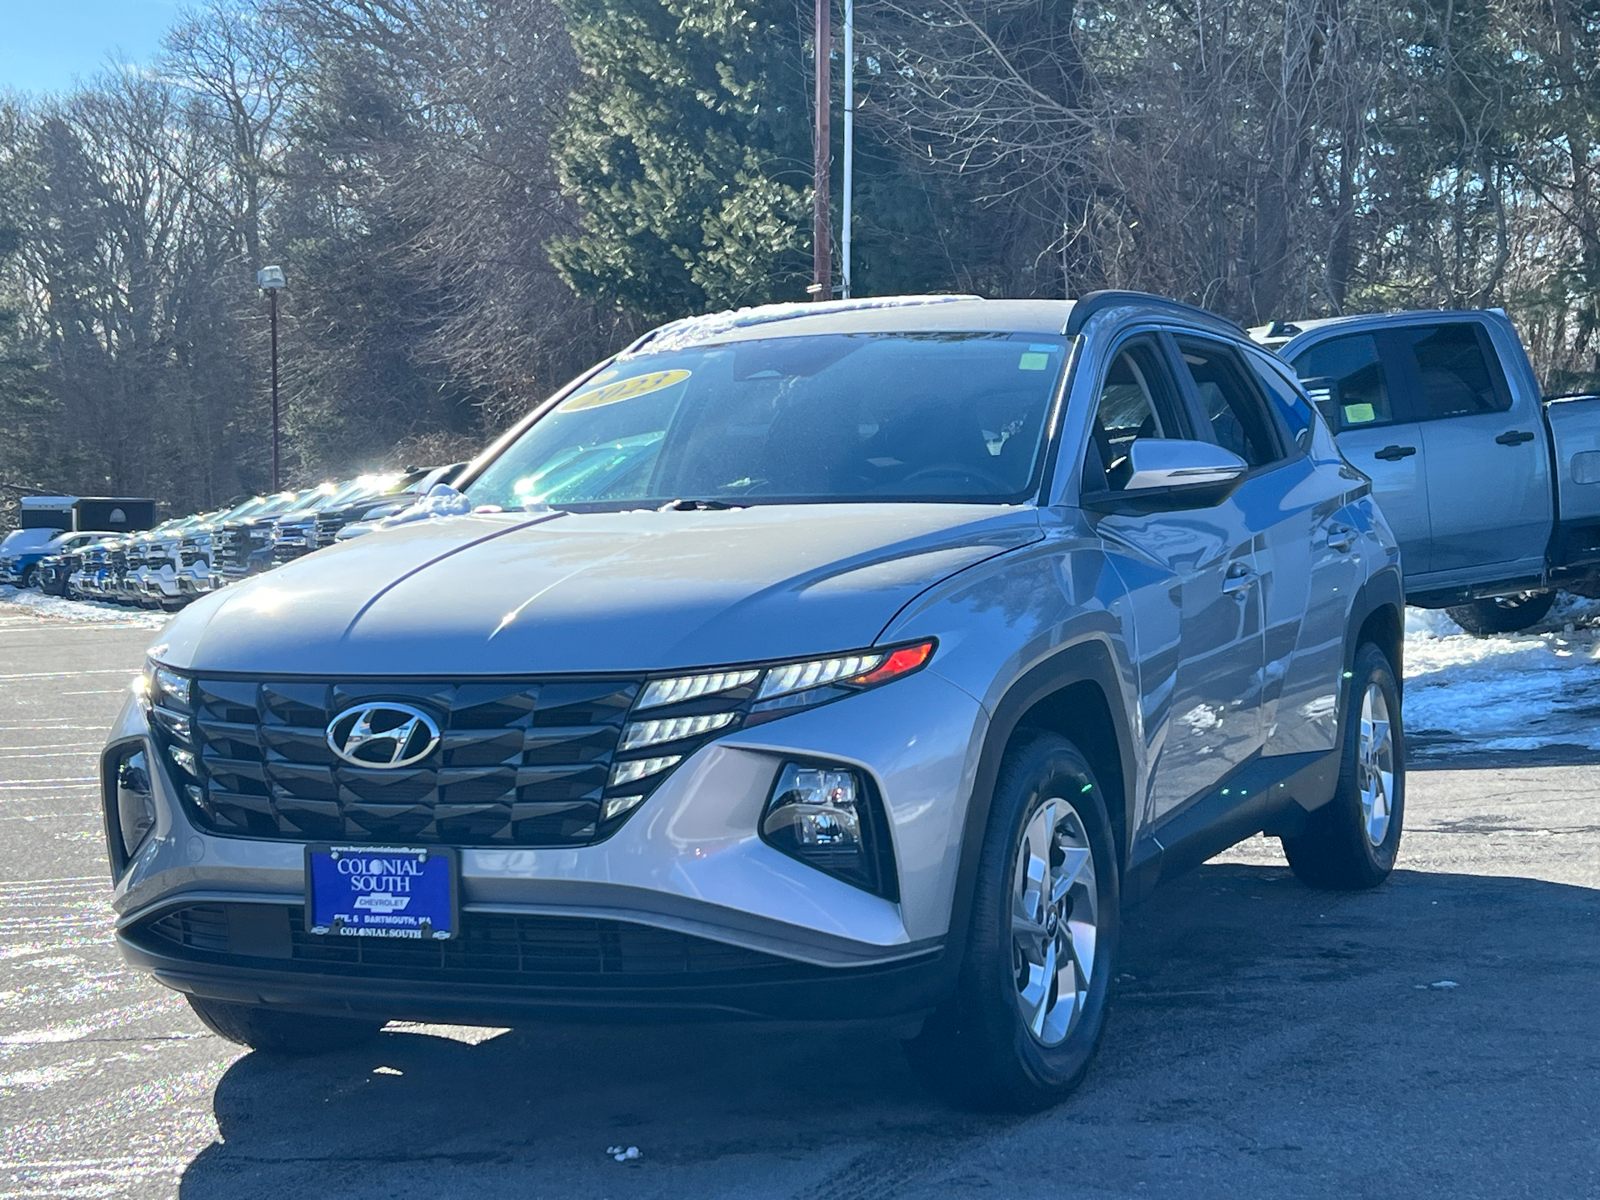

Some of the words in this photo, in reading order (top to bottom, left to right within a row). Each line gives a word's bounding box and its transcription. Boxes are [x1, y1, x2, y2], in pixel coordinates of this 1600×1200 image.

[337, 858, 424, 876] COLONIAL
[351, 875, 411, 892] SOUTH
[359, 898, 405, 907] CHEVROLET
[340, 927, 388, 937] COLONIAL
[388, 929, 422, 939] SOUTH
